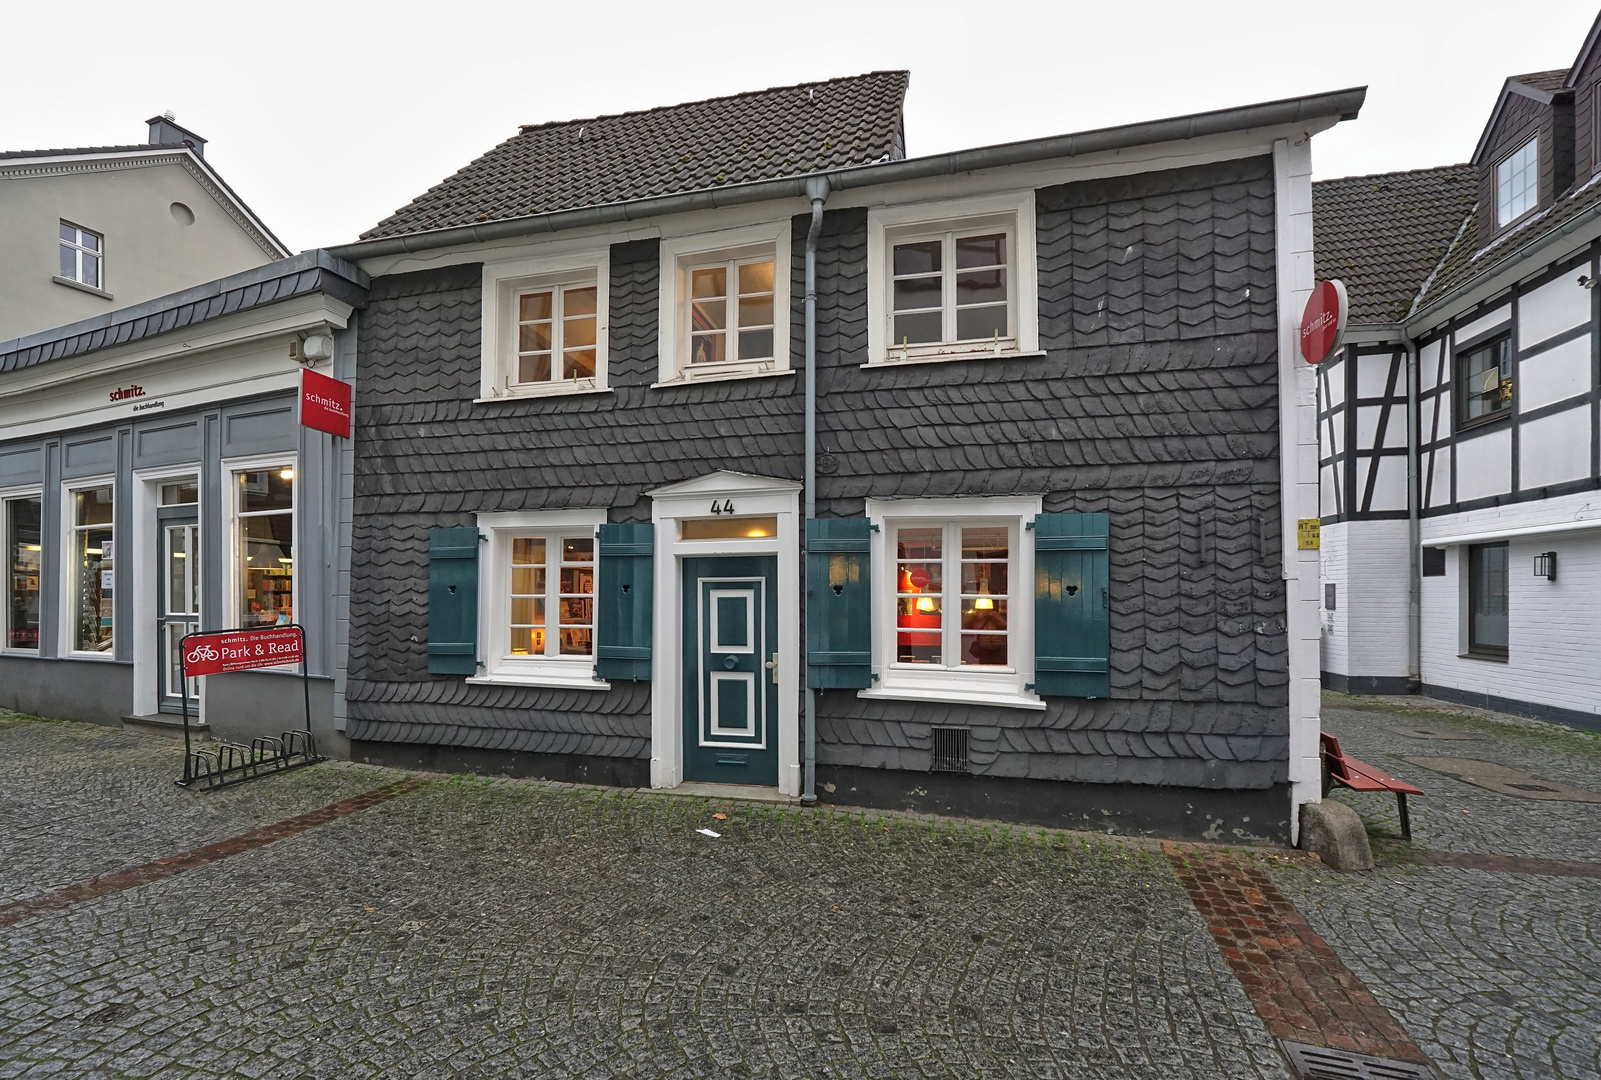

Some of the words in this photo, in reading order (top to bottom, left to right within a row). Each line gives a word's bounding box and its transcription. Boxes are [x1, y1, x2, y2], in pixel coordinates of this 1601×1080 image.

[1303, 311, 1333, 338] schmitz.
[110, 384, 146, 402] schmitz.
[306, 392, 343, 411] schmitz.
[710, 499, 734, 515] 44
[222, 645, 250, 659] Park
[255, 644, 264, 655] &
[268, 640, 299, 654] Read
